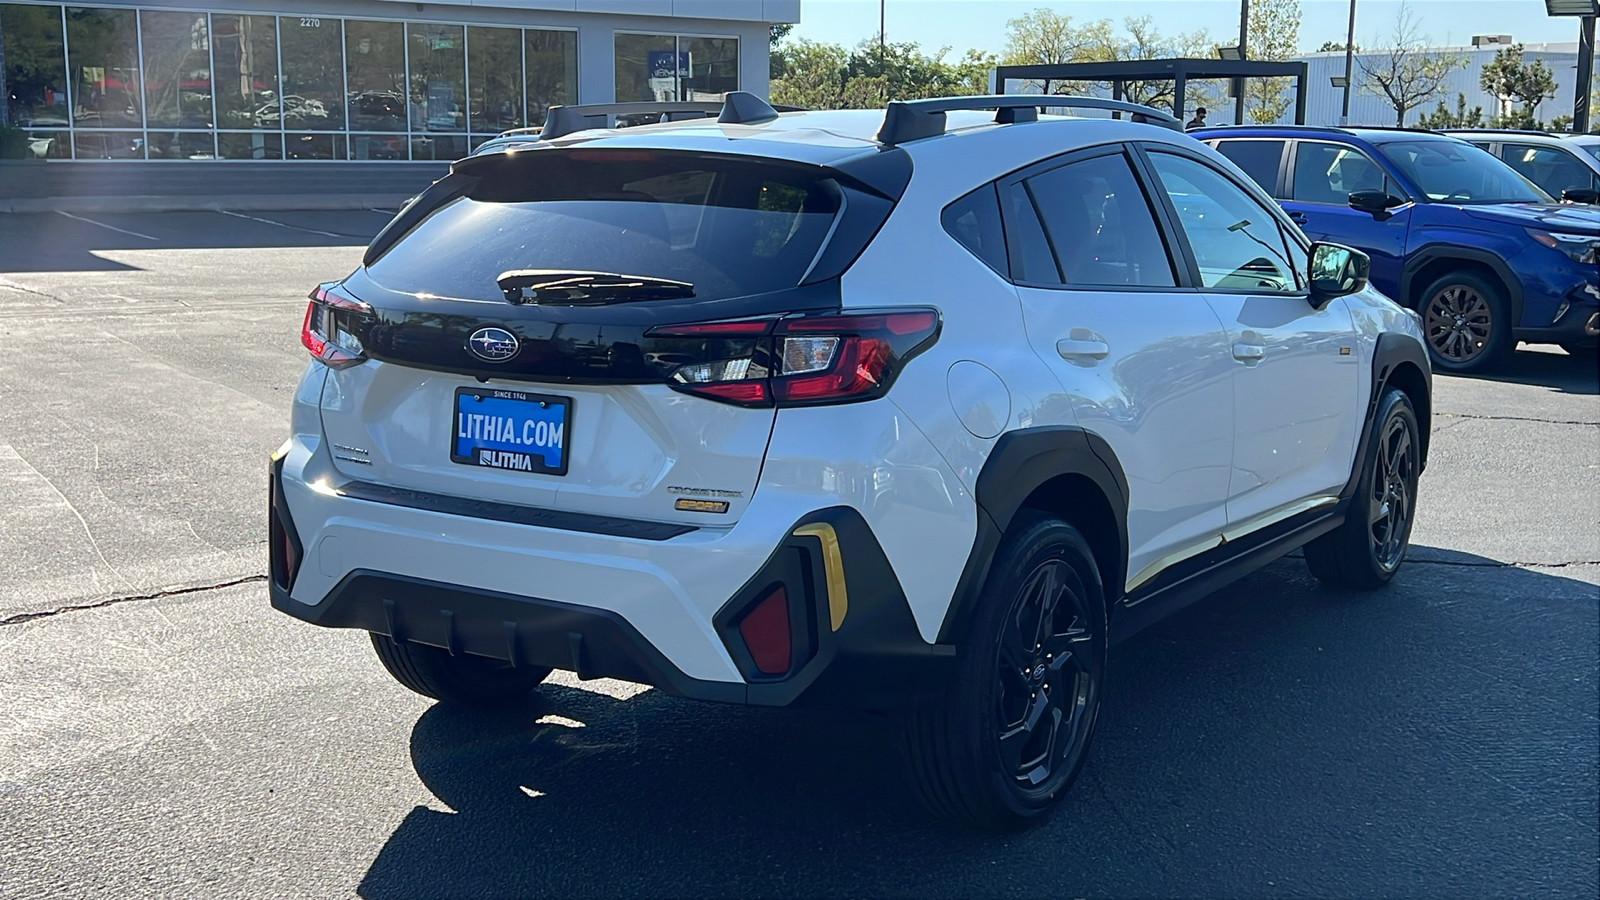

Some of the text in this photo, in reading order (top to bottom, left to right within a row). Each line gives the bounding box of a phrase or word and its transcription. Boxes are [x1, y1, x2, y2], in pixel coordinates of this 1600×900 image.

[300, 17, 320, 28] 2270
[493, 390, 512, 399] SINCE
[458, 412, 564, 449] LITHIA.COM
[491, 450, 532, 471] LITHIA
[667, 486, 744, 498] CROSSTREK
[679, 500, 723, 511] SPORT
